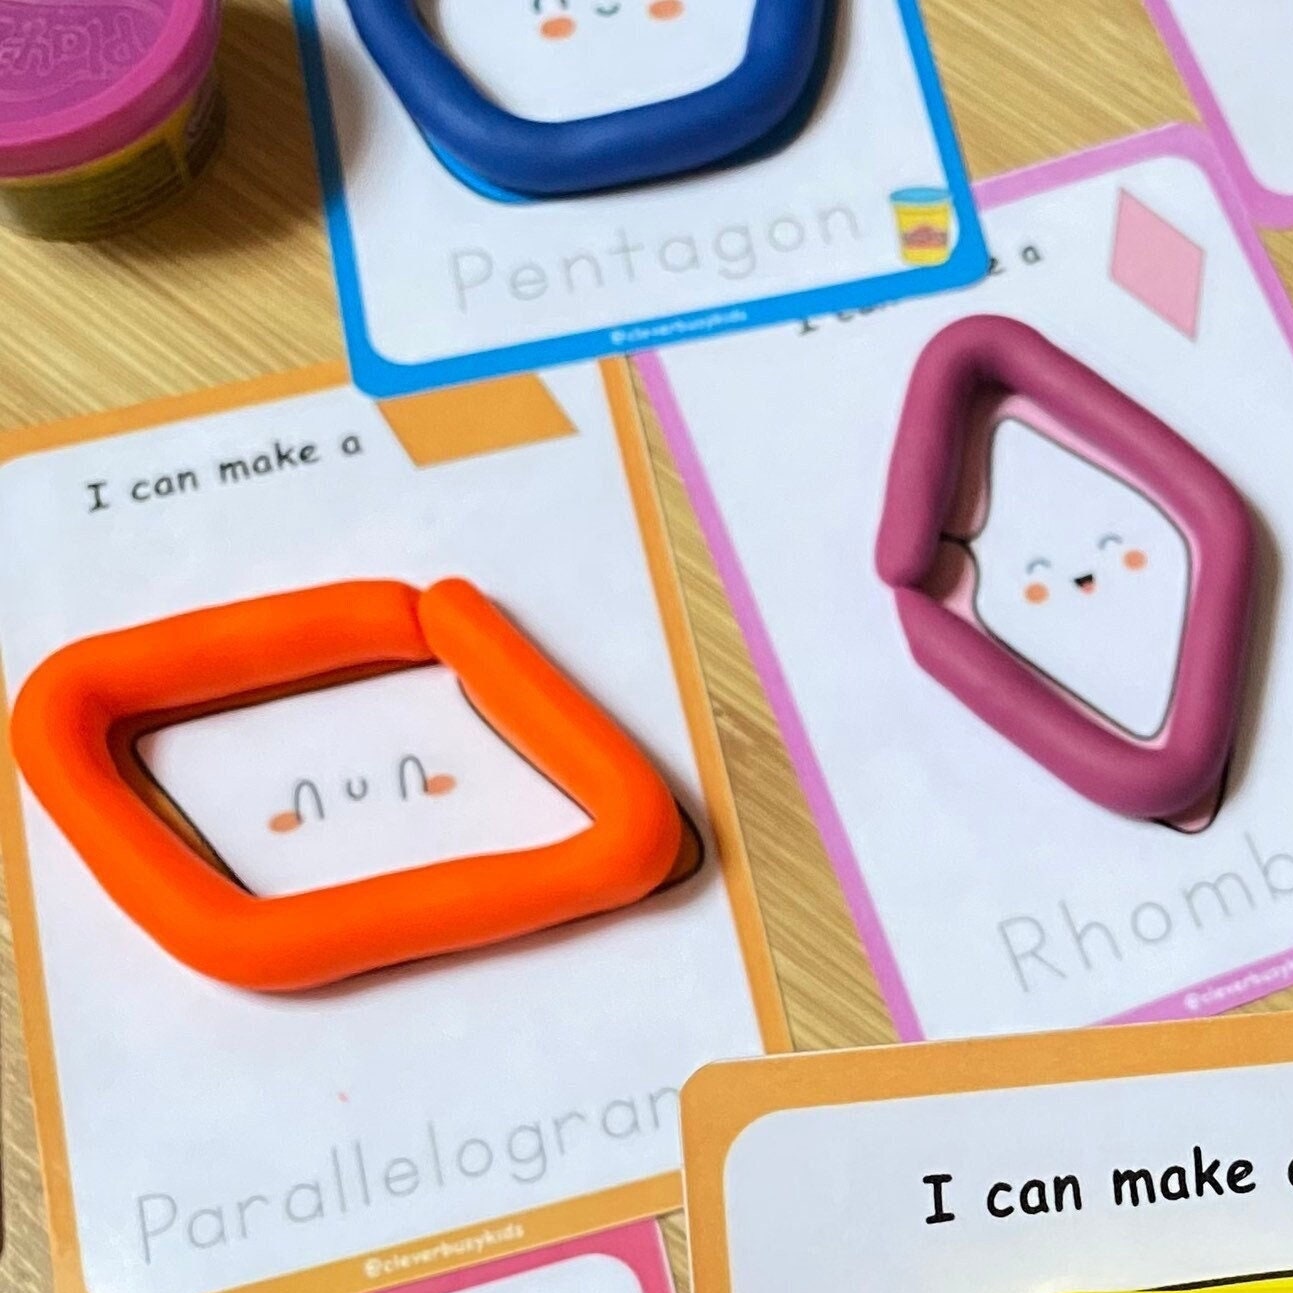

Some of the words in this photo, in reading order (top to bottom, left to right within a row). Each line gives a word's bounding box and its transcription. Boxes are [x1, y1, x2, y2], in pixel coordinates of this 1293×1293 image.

[447, 200, 861, 312] Pentagon
[86, 481, 109, 513] I
[130, 470, 199, 503] can
[218, 440, 319, 484] make
[340, 434, 364, 457] a
[922, 1172, 956, 1225] I
[986, 1174, 1083, 1219] can
[1112, 1145, 1258, 1208] make
